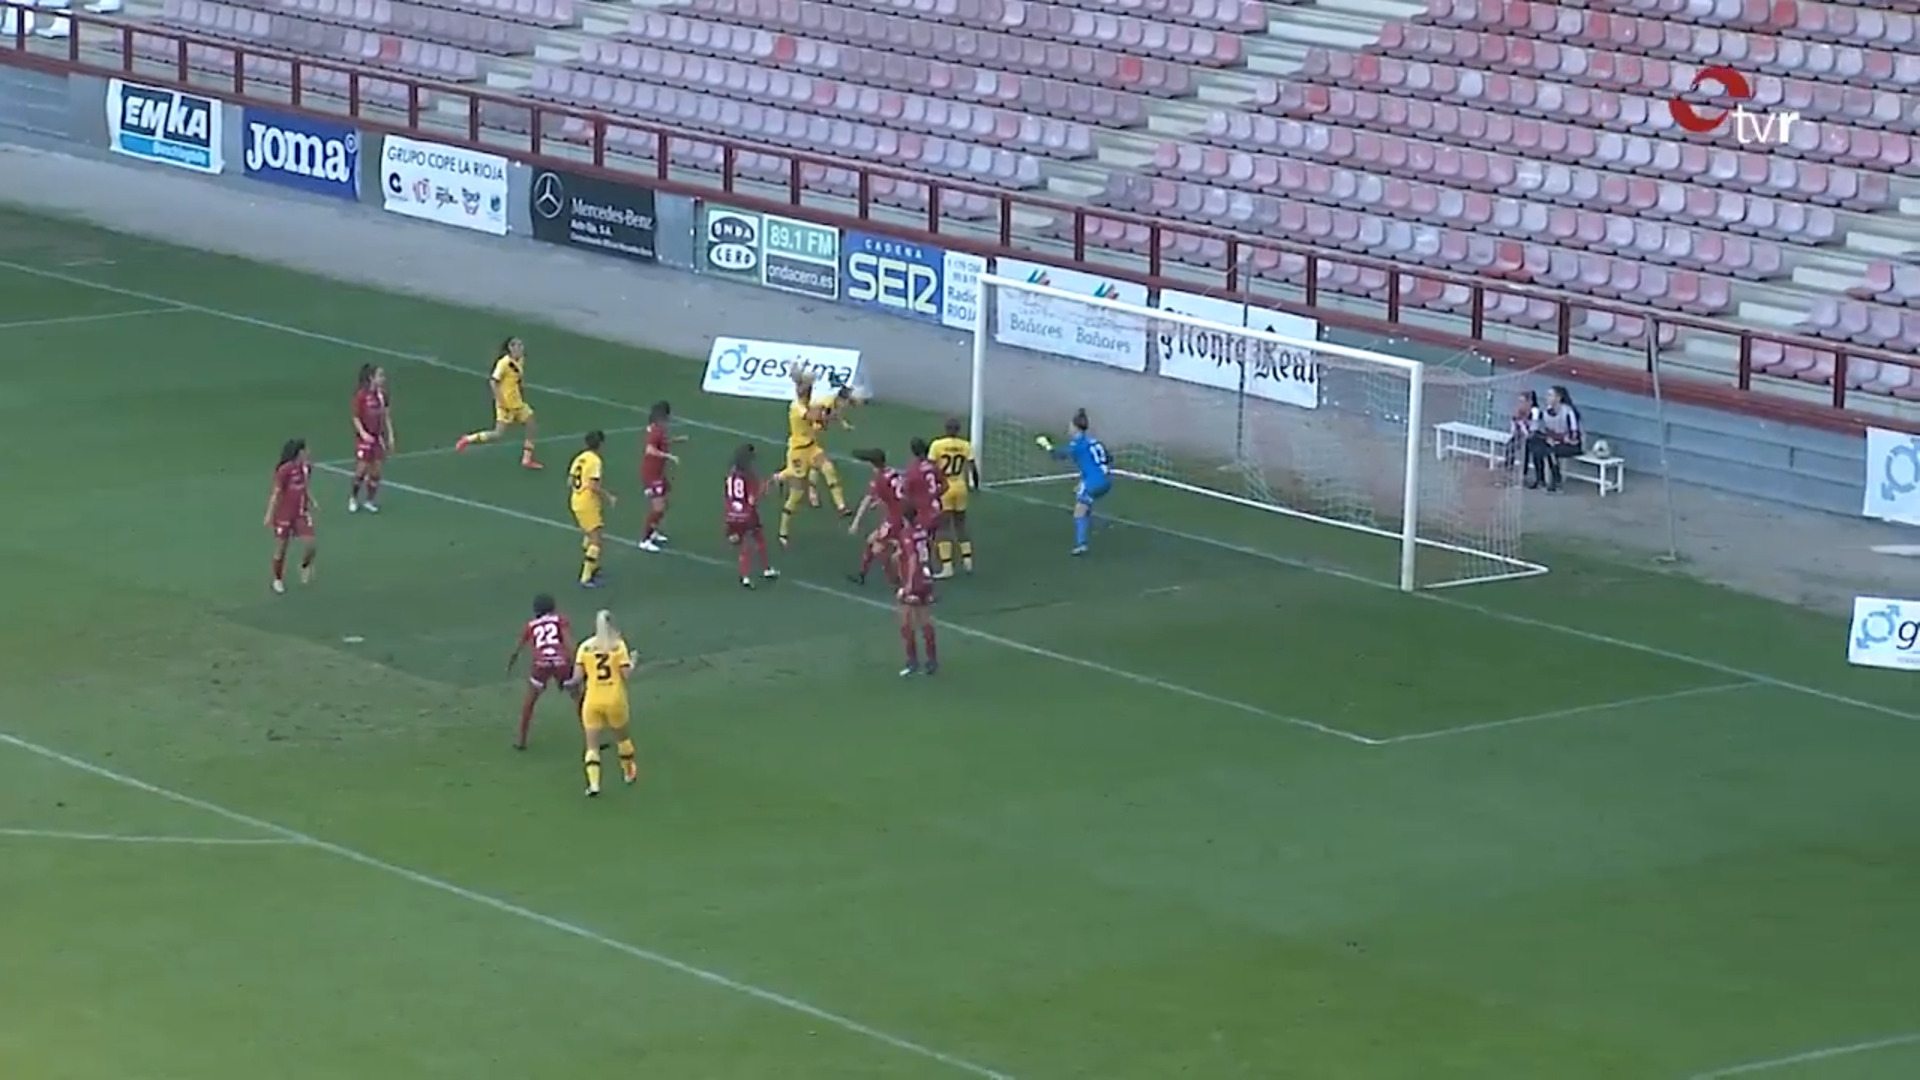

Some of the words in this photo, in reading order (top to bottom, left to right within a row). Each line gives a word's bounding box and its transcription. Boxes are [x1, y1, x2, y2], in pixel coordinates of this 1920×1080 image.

[123, 95, 208, 140] EMKA
[387, 145, 426, 167] GRUPO
[428, 152, 457, 173] COPE
[458, 157, 471, 176] LA
[473, 161, 505, 181] RIOJA
[571, 197, 654, 231] Mercedes-Benz
[711, 221, 753, 241] ONDA
[770, 224, 801, 249] 89.1
[807, 231, 833, 257] FM
[715, 249, 752, 267] CERO
[864, 238, 923, 259] CADENA
[768, 262, 834, 290] ondacero.es
[848, 251, 938, 315] SER
[940, 454, 965, 476] 20
[725, 476, 746, 499] 18
[533, 623, 560, 648] 22
[595, 652, 612, 681] 3
